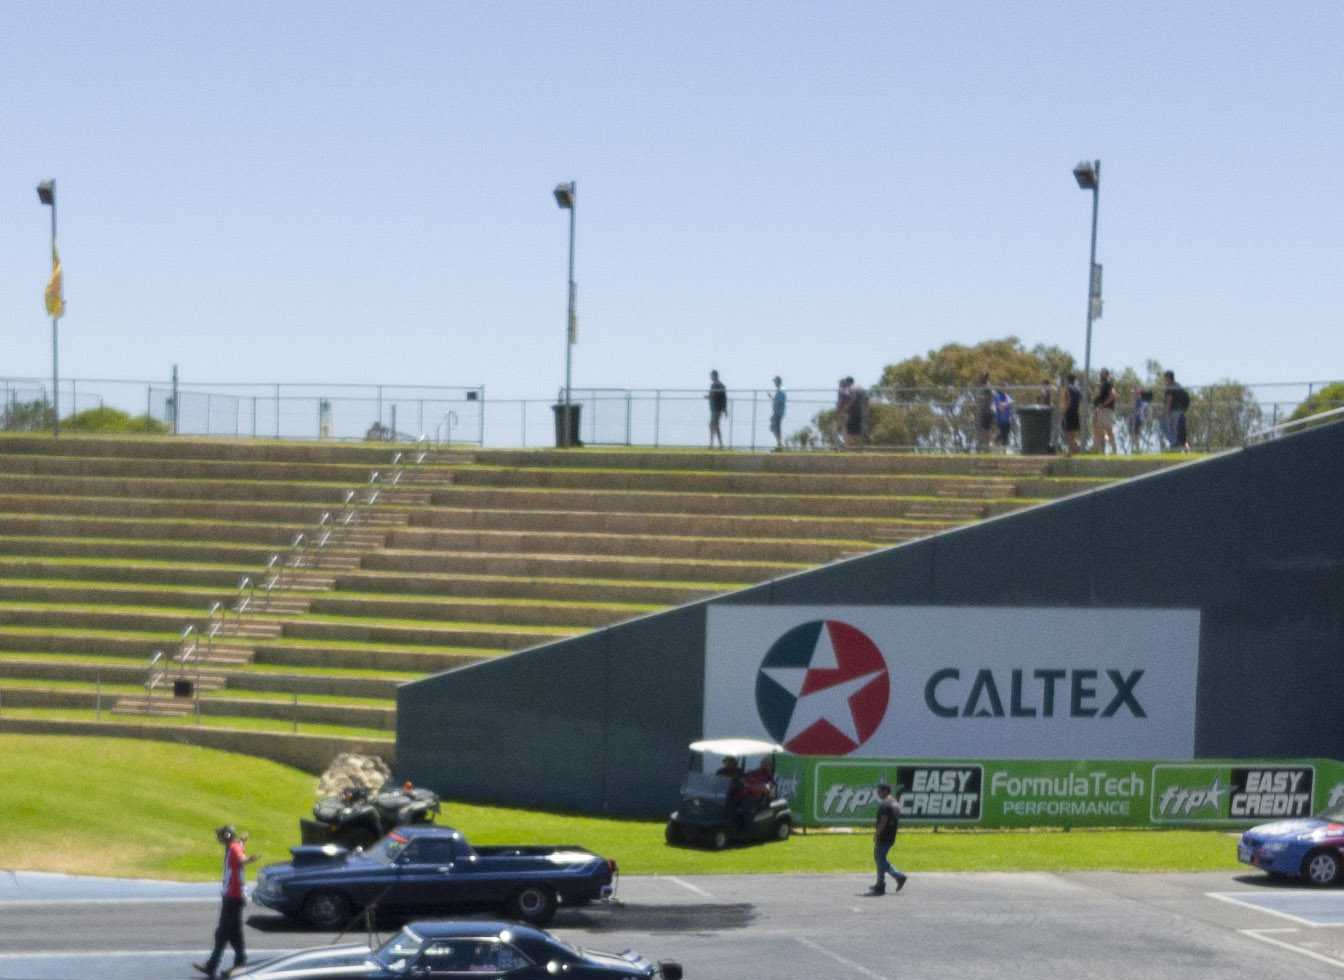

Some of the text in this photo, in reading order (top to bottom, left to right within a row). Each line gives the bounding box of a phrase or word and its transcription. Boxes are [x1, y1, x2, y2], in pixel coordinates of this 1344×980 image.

[924, 667, 1148, 719] CALTEX
[912, 770, 972, 792] EASY
[1245, 771, 1304, 793] EASY
[899, 793, 977, 815] CREDIT
[1003, 801, 1129, 817] PERFORMANCE
[1231, 793, 1309, 816] CREDIT
